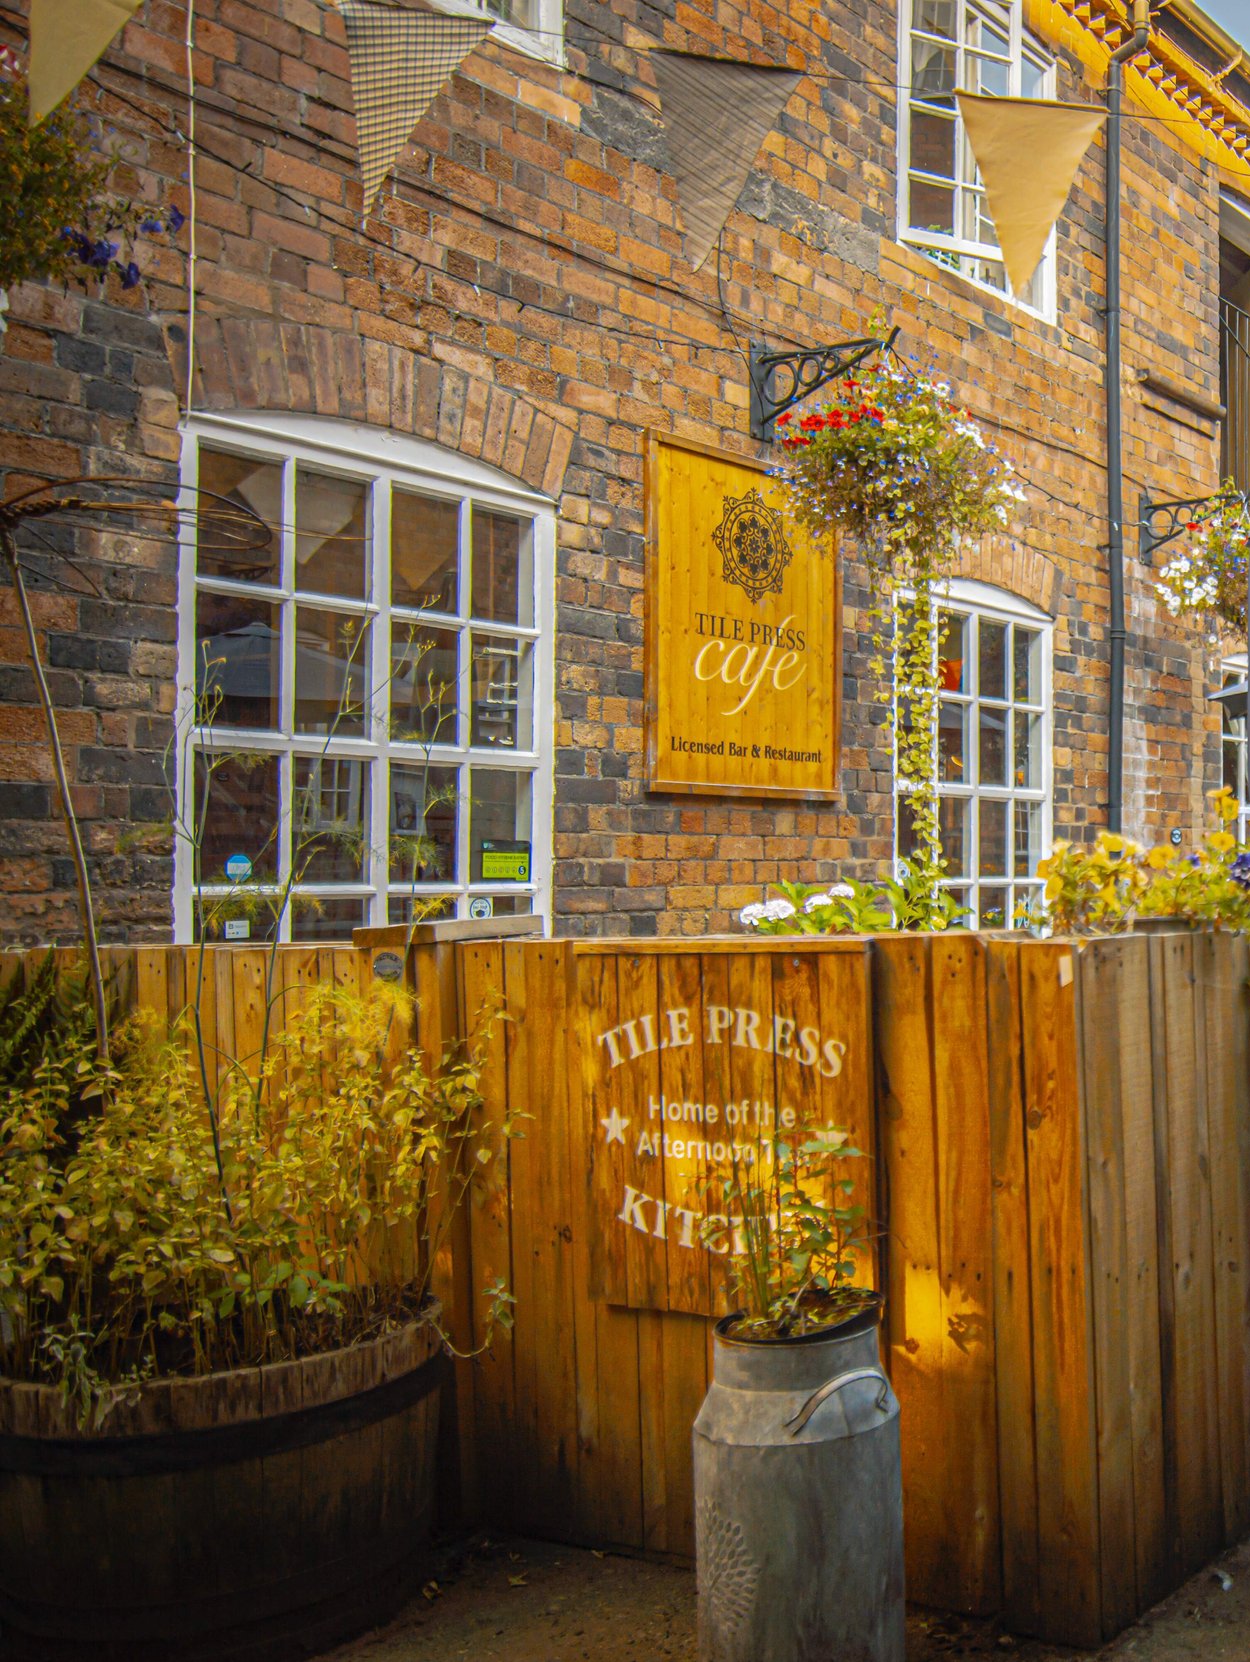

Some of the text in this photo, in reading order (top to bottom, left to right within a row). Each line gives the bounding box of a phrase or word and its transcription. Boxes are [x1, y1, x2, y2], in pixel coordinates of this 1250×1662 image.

[694, 612, 805, 651] TILE PRESS
[671, 735, 821, 764] Licensed Bar & Restaurant
[597, 1006, 847, 1078] TILE PRESS
[648, 1095, 797, 1128] Home of the
[637, 1131, 756, 1162] Afternoon
